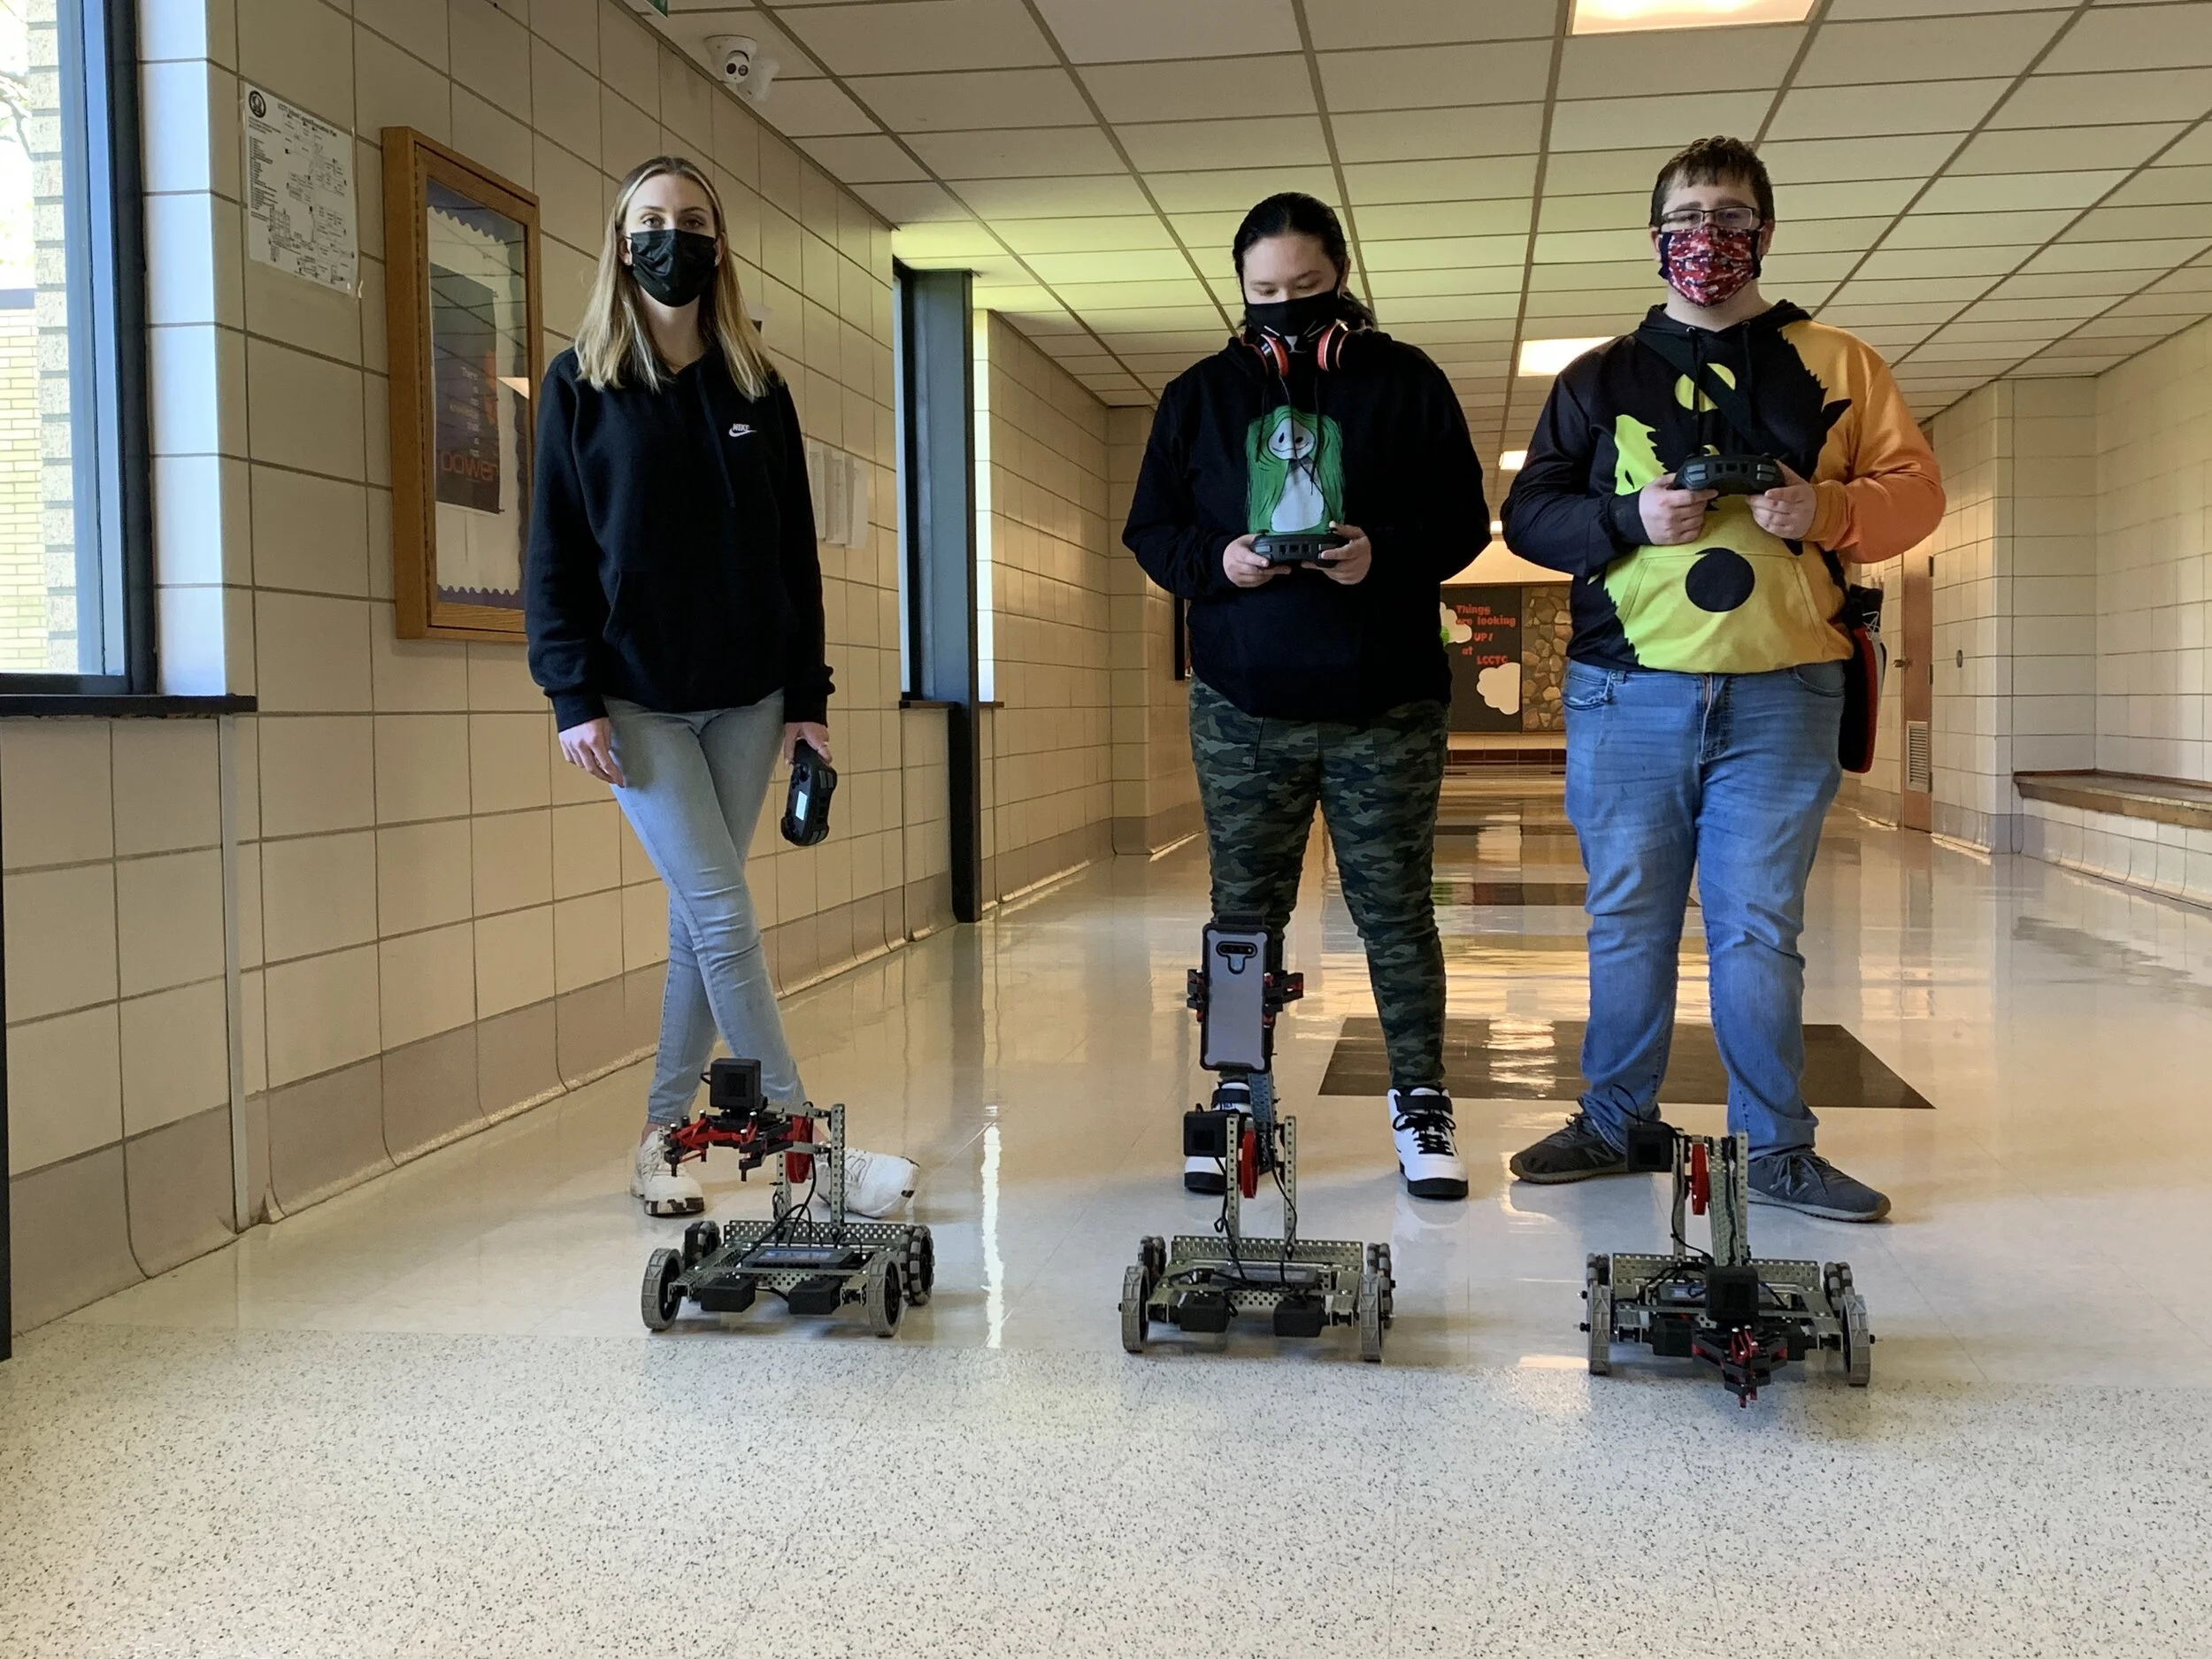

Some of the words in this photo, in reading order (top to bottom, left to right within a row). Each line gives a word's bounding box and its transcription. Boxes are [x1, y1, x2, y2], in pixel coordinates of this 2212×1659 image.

[733, 423, 750, 432] NIKE
[442, 451, 497, 480] power
[1455, 604, 1491, 615] Things
[1478, 615, 1516, 627] looking
[1462, 646, 1473, 656] at
